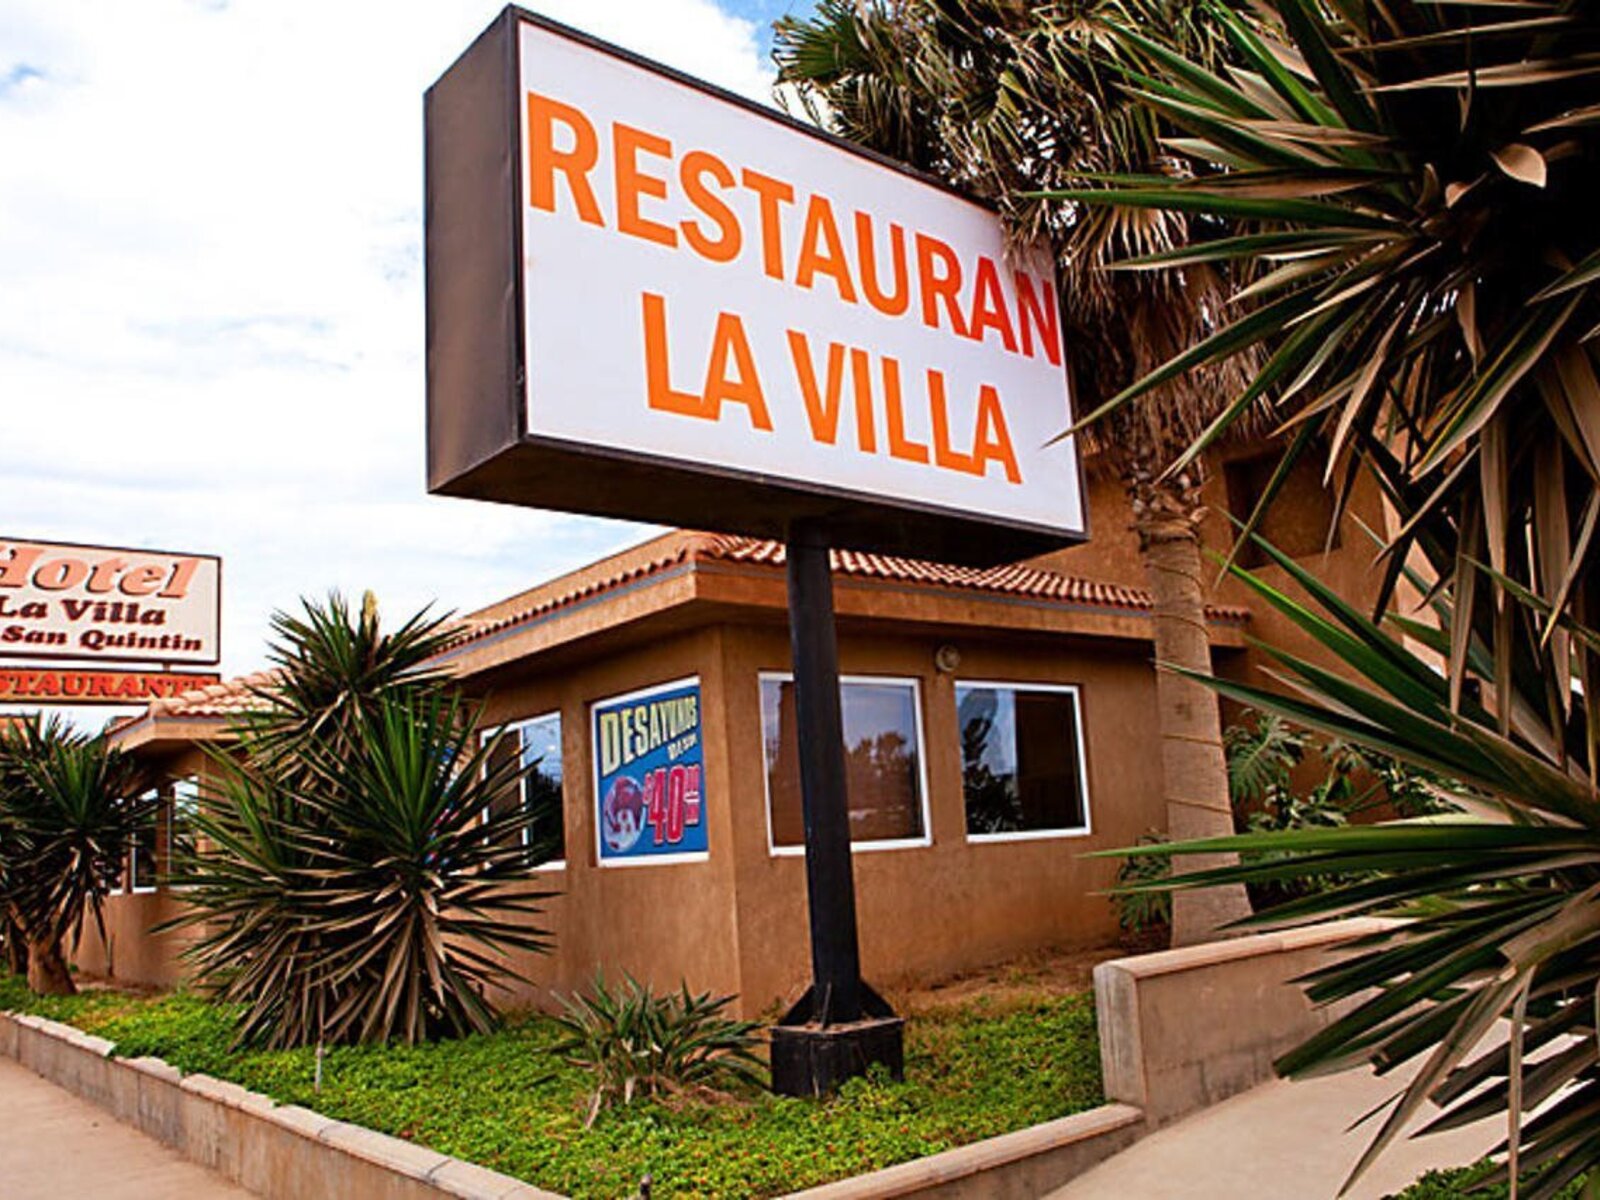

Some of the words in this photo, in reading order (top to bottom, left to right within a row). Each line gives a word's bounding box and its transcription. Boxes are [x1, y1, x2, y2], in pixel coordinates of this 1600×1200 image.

[526, 90, 1062, 367] RESTAURAN
[641, 292, 774, 432] LA
[785, 328, 1023, 485] VILLA
[0, 595, 48, 619] La
[60, 598, 166, 626] Villa
[1, 624, 68, 645] San
[79, 629, 202, 651] Quintin
